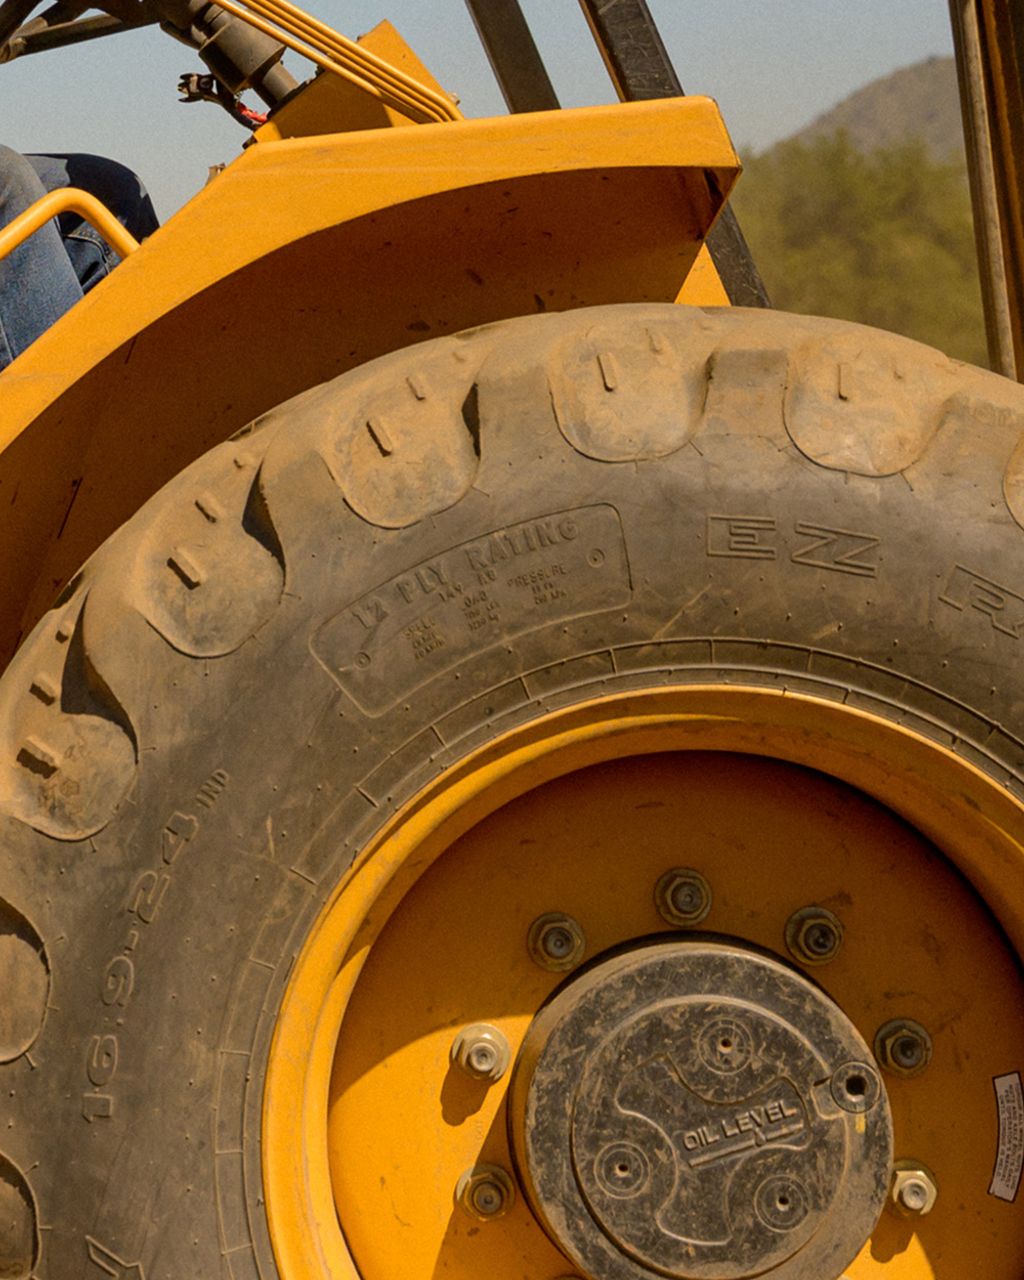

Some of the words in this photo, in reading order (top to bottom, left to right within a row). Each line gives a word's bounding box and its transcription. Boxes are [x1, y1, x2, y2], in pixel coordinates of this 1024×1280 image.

[352, 596, 389, 629] 12
[395, 561, 448, 604] PLY
[465, 520, 577, 570] RATING
[196, 769, 229, 809] IND
[683, 1126, 720, 1151] OIL
[721, 1100, 797, 1138] LEVEL
